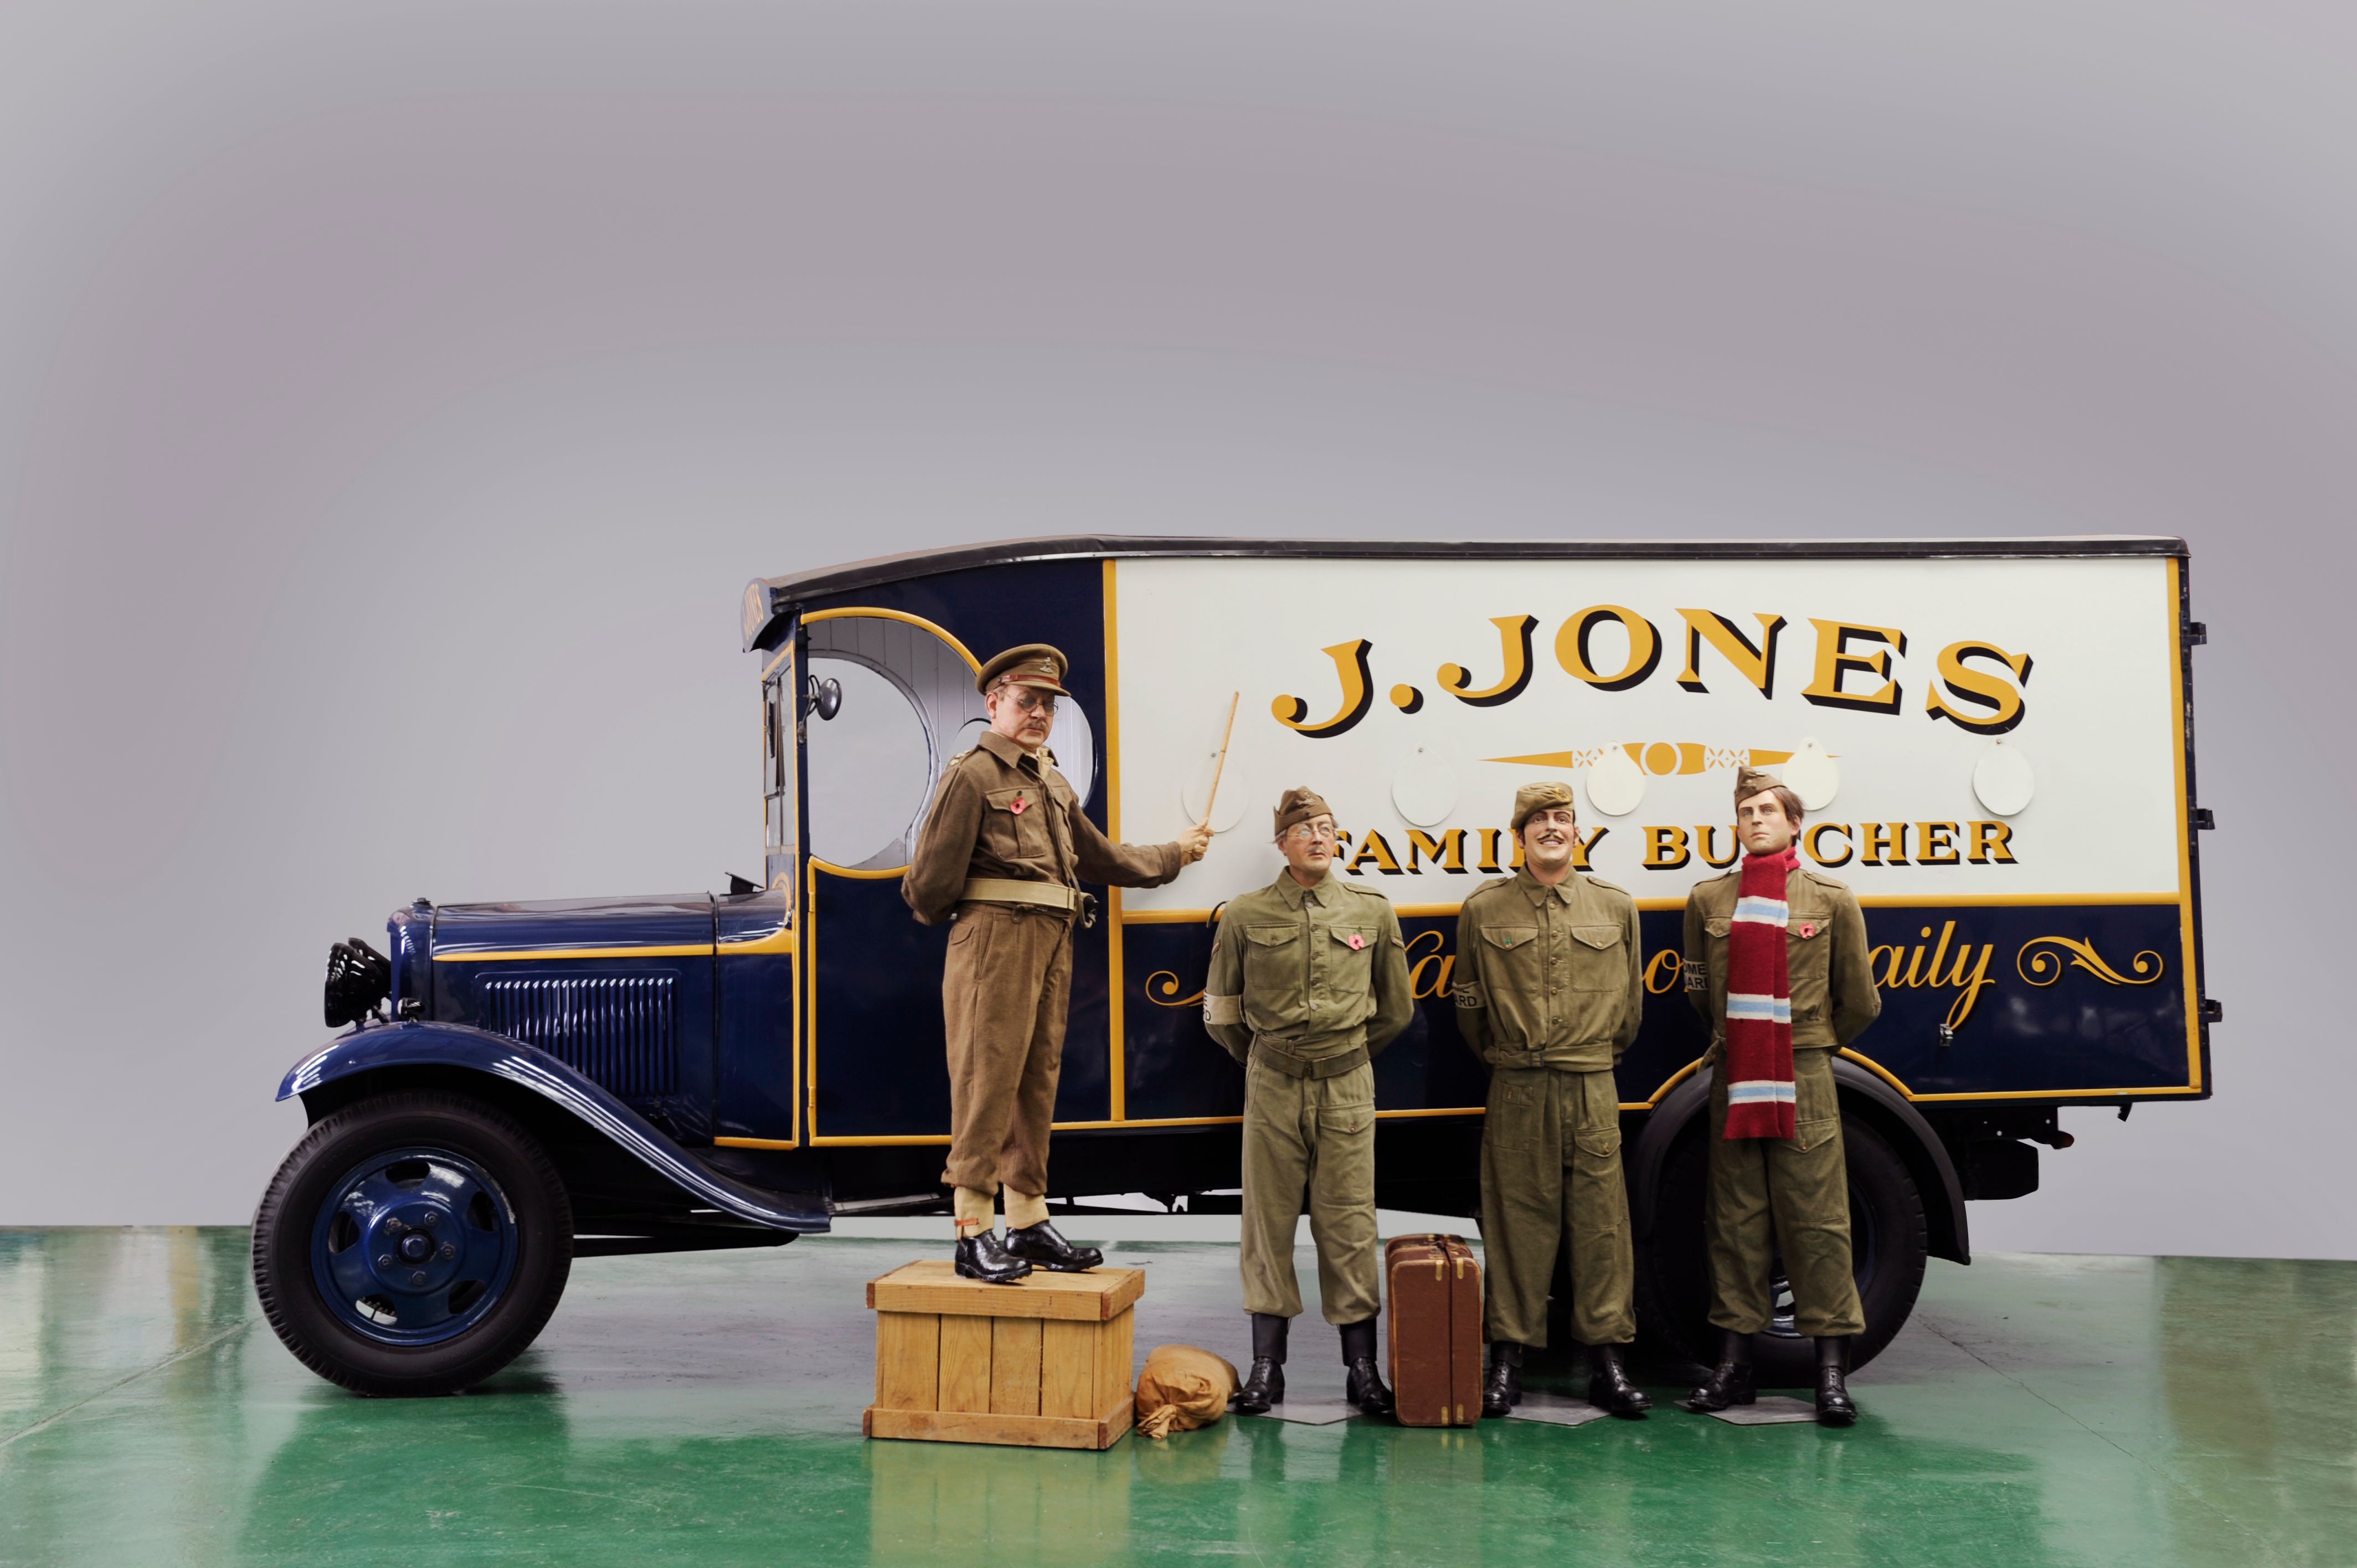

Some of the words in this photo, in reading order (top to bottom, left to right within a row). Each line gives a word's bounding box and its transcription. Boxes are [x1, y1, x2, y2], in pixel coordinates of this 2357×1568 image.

[1271, 638, 1424, 739] J.
[1437, 604, 2034, 735] JONES
[1641, 821, 2020, 871] BUCHER
[1869, 921, 1995, 1030] aily
